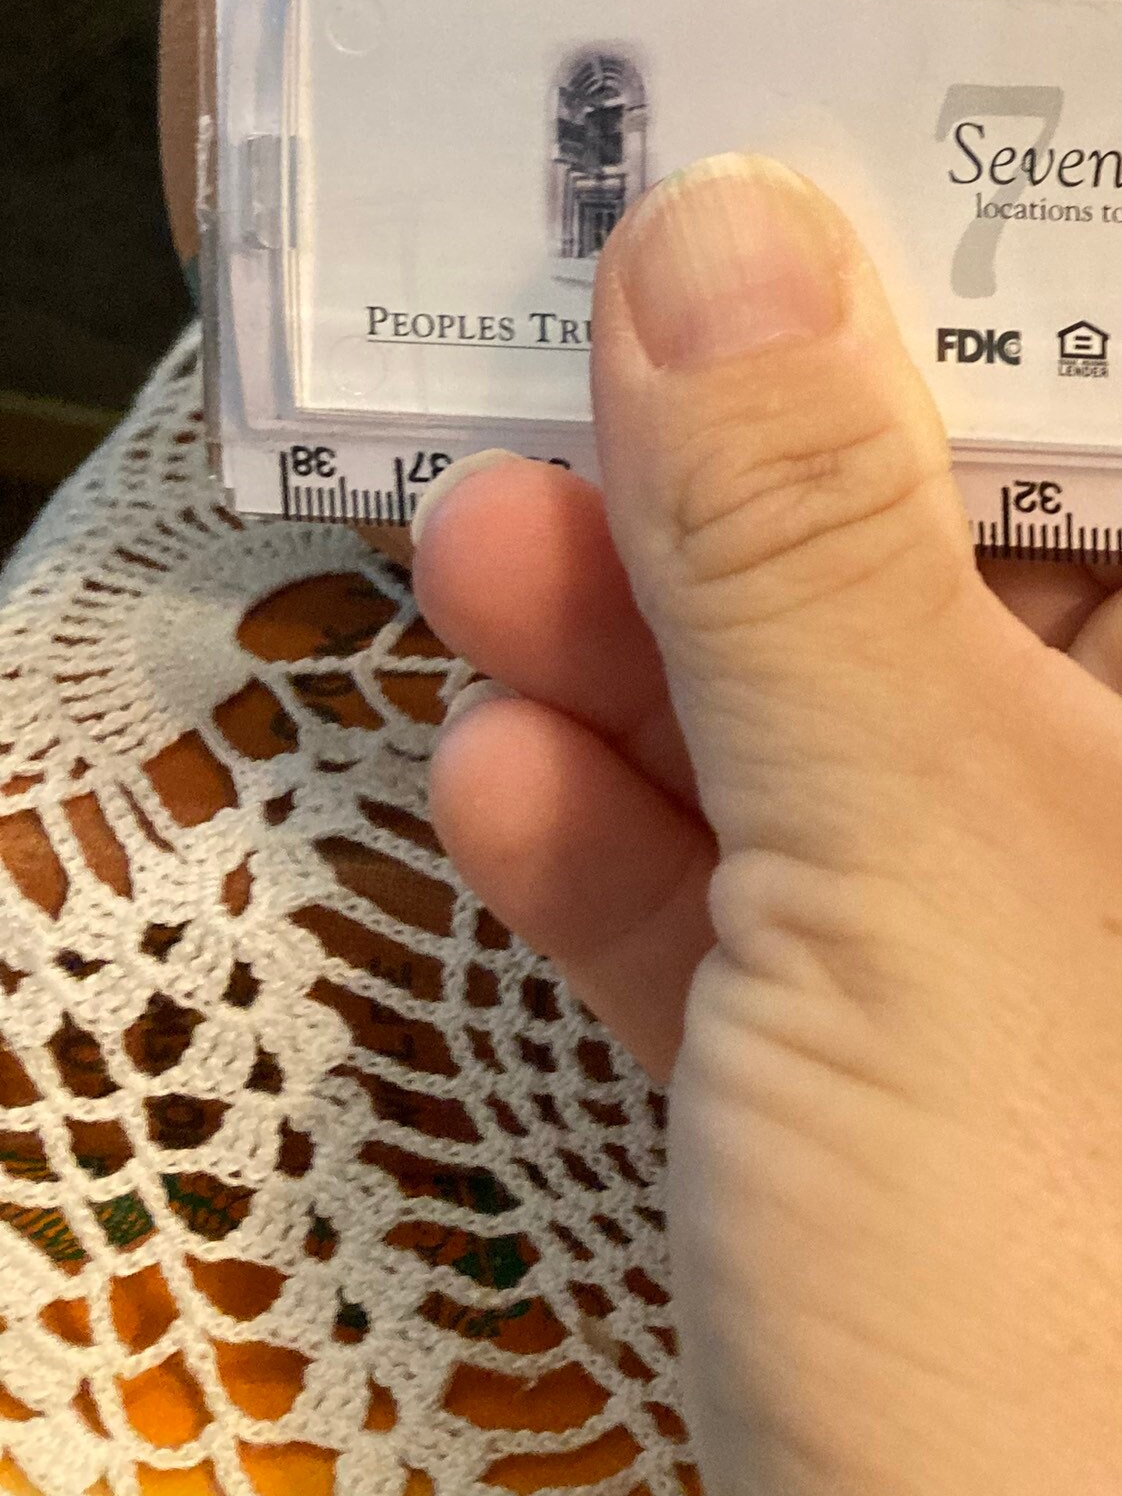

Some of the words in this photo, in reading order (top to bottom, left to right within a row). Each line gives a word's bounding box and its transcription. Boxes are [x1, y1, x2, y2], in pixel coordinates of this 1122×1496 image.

[934, 83, 1065, 300] 7
[975, 193, 1094, 223] locations
[936, 327, 1022, 366] FDIC
[291, 445, 336, 478] 38
[1013, 480, 1063, 515] 32
